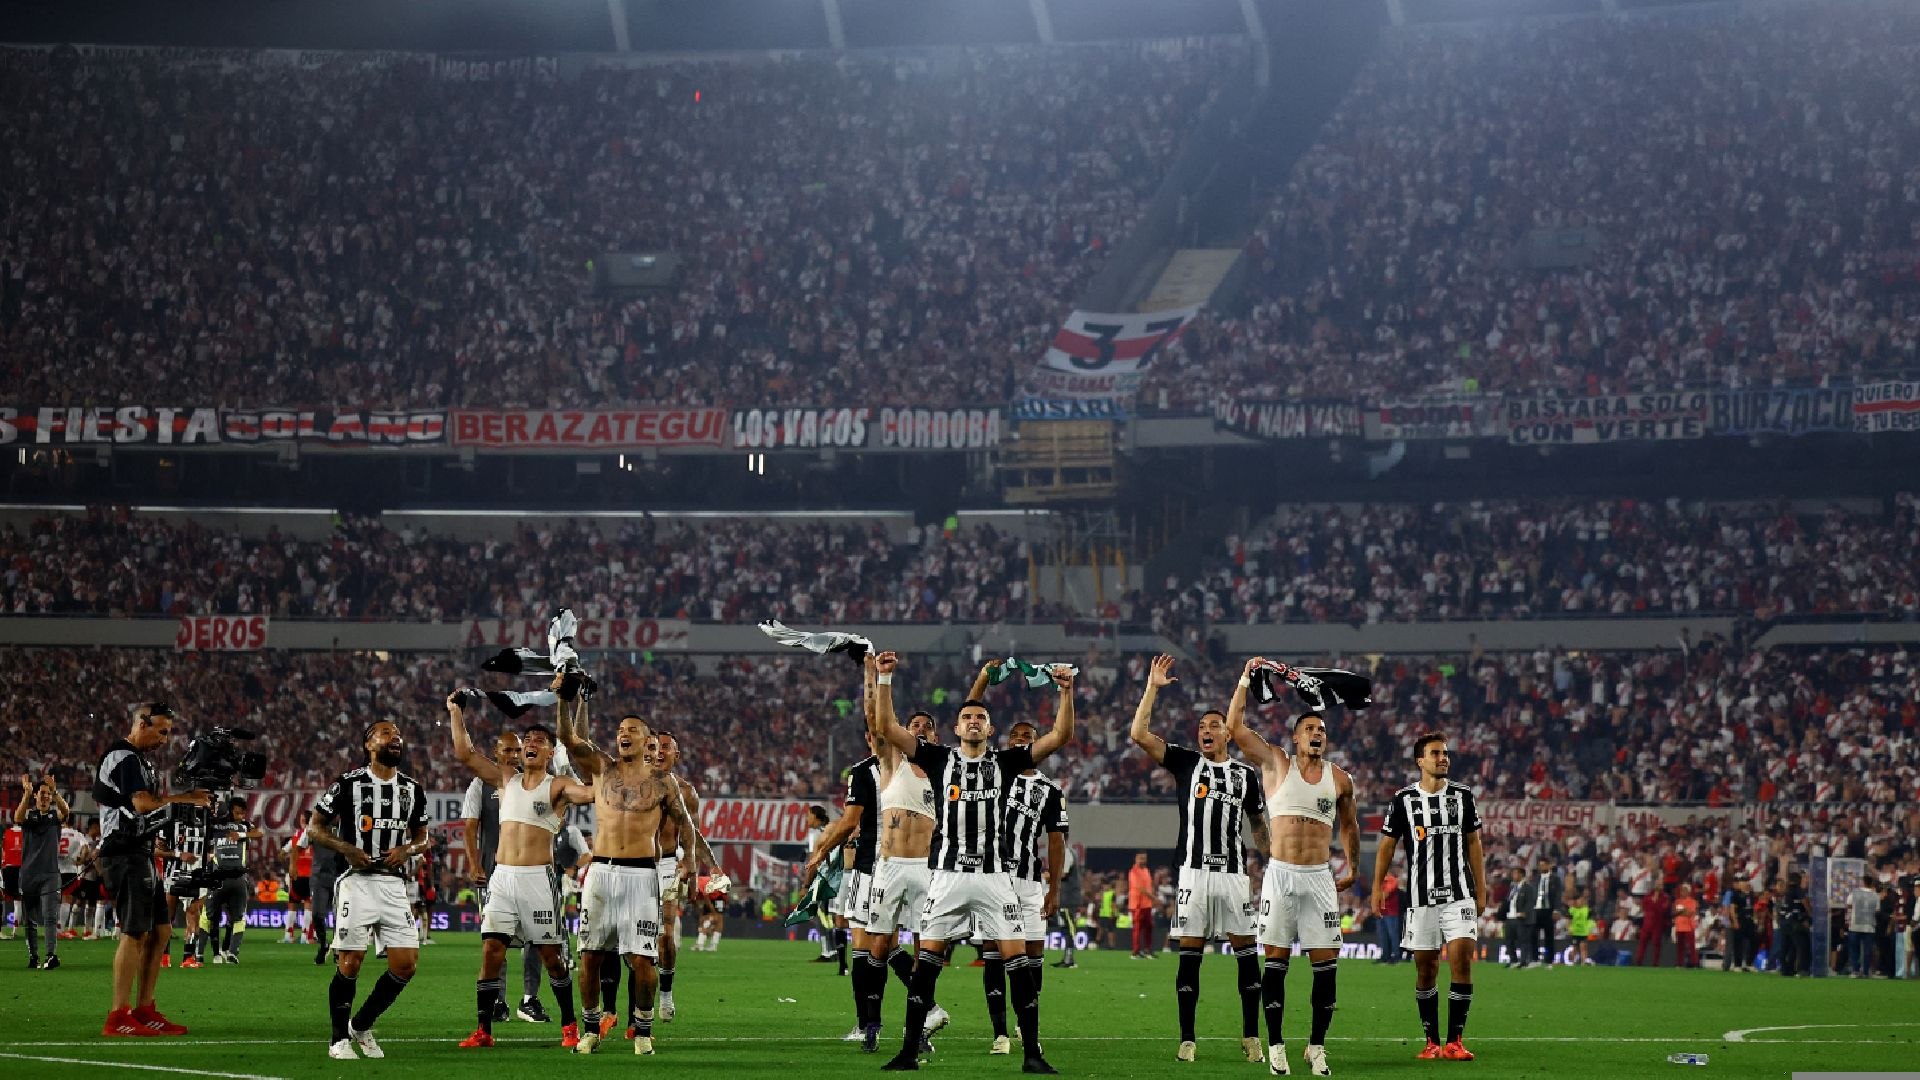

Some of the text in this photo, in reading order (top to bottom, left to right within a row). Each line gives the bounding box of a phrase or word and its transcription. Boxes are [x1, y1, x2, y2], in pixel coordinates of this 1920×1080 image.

[1069, 316, 1185, 370] 37
[1640, 393, 1707, 414] SOLO
[1713, 389, 1852, 433] BURZACO
[36, 407, 221, 443] FIESTA
[457, 409, 727, 445] BERAZATEGUI
[733, 408, 870, 448] LOS VAGOS
[880, 407, 1000, 448] CORDOBA
[1512, 416, 1700, 443] CON VERTE
[465, 619, 660, 649] ALMGRO
[960, 788, 999, 801] BETANO
[1208, 789, 1242, 806] BETANO
[700, 800, 810, 841] CABALLITO
[1483, 802, 1595, 824] UZURIAGA
[342, 902, 350, 918] 5
[1178, 888, 1192, 905] 27
[533, 910, 553, 918] AUTO
